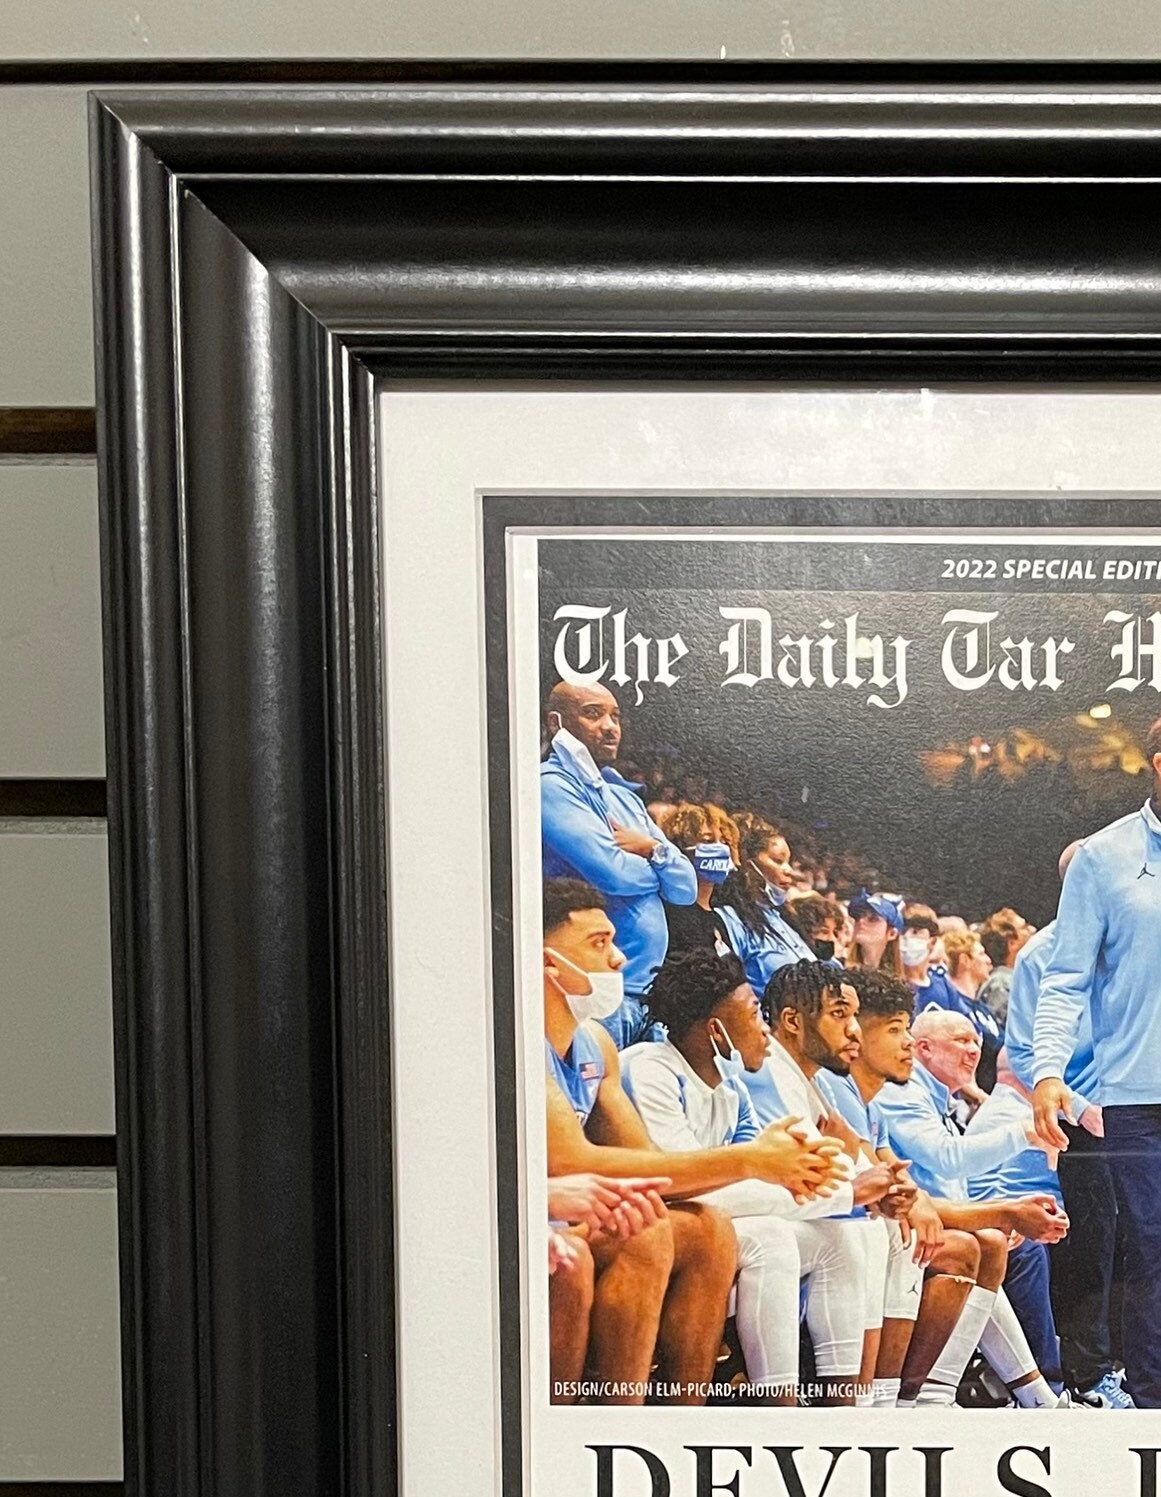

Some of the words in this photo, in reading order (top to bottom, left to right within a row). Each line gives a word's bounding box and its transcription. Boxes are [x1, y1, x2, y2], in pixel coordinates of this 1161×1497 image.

[941, 559, 997, 578] 2022
[1003, 560, 1096, 579] SPECIAL
[553, 604, 691, 707] The
[719, 605, 914, 708] Daily
[942, 608, 1076, 692] Tar
[554, 1382, 652, 1397] DESIGN/CARSON
[656, 1382, 736, 1399] ELM-PICARD;
[739, 1383, 823, 1398] PHOTO/HELEN
